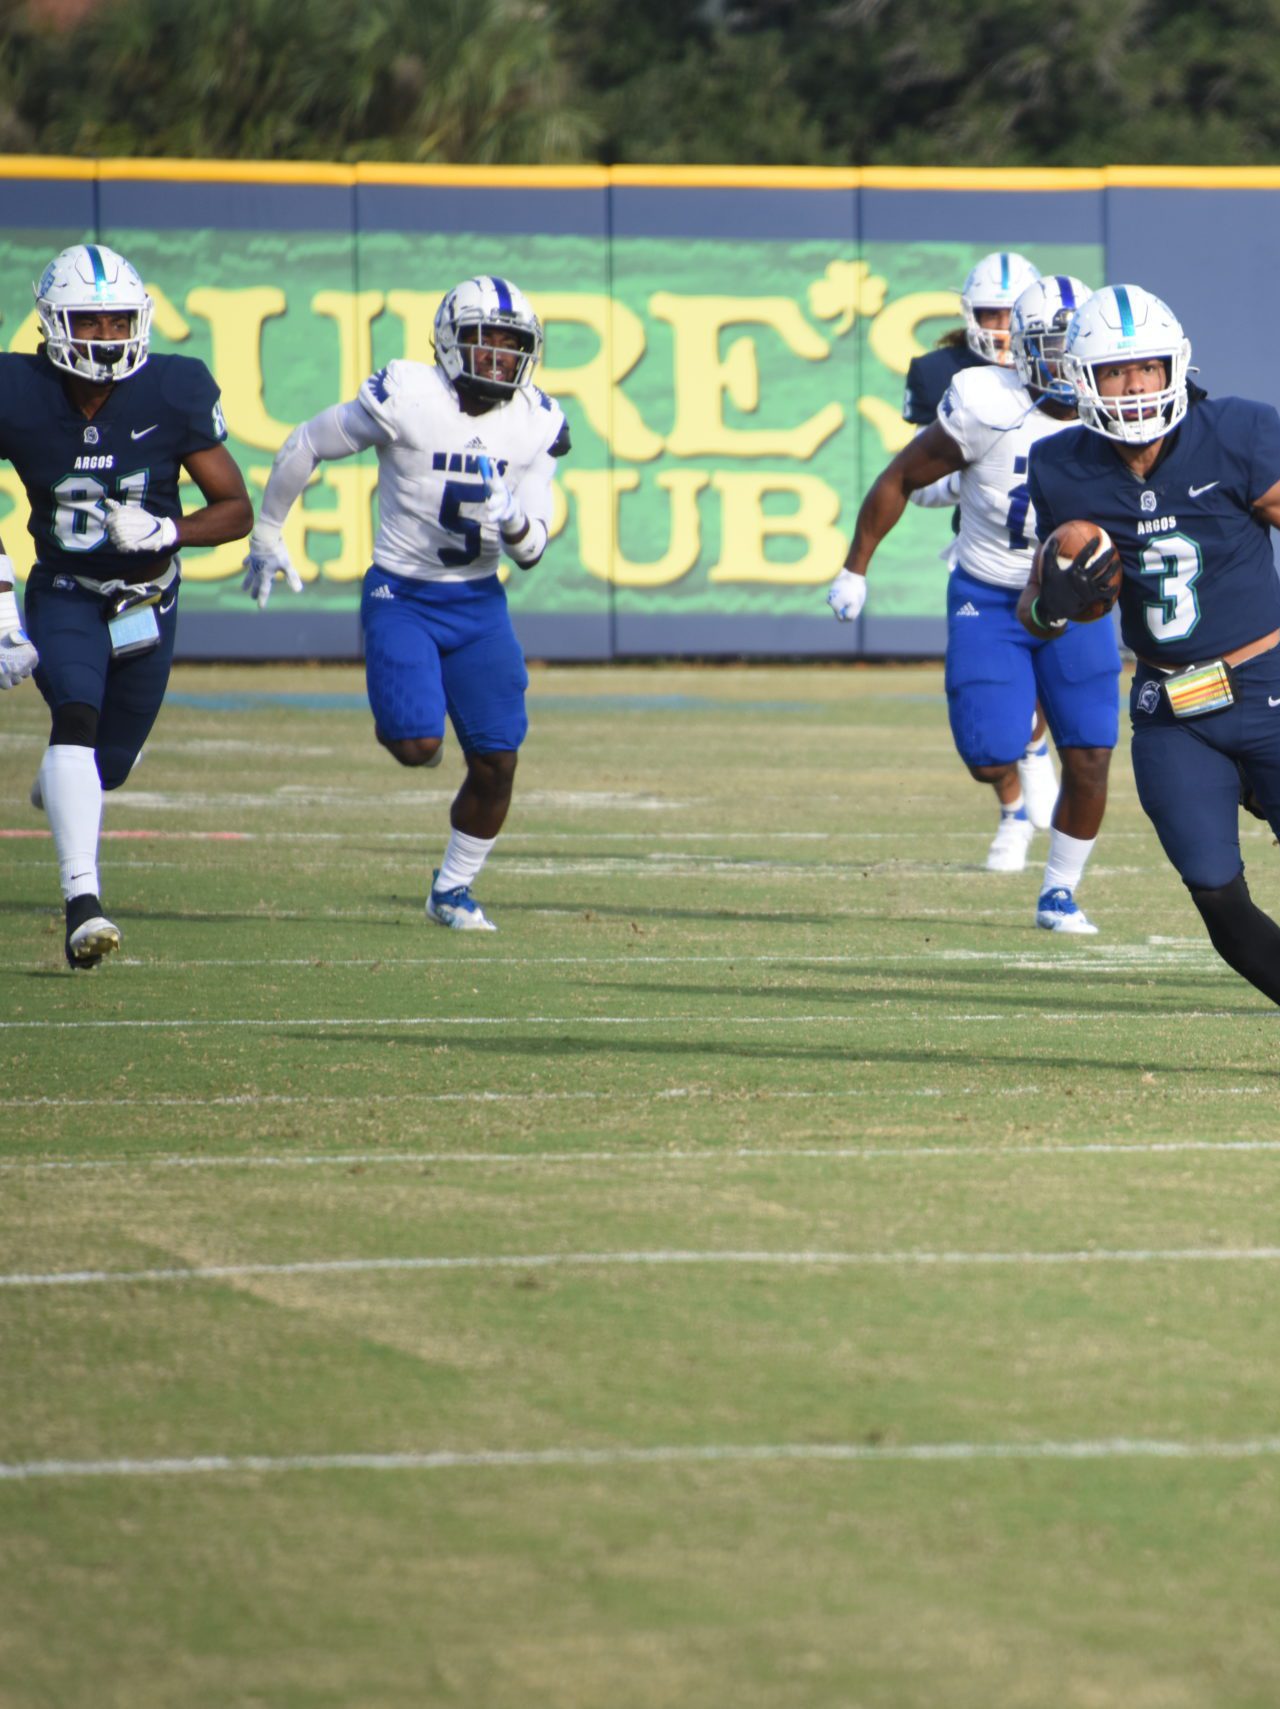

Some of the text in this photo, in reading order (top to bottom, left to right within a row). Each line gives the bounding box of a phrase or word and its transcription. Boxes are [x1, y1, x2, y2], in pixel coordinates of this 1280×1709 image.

[73, 454, 114, 470] ARGOS
[432, 452, 509, 477] HAWS
[437, 480, 492, 567] 5
[1136, 515, 1177, 536] ARGOS
[1138, 531, 1204, 644] 3
